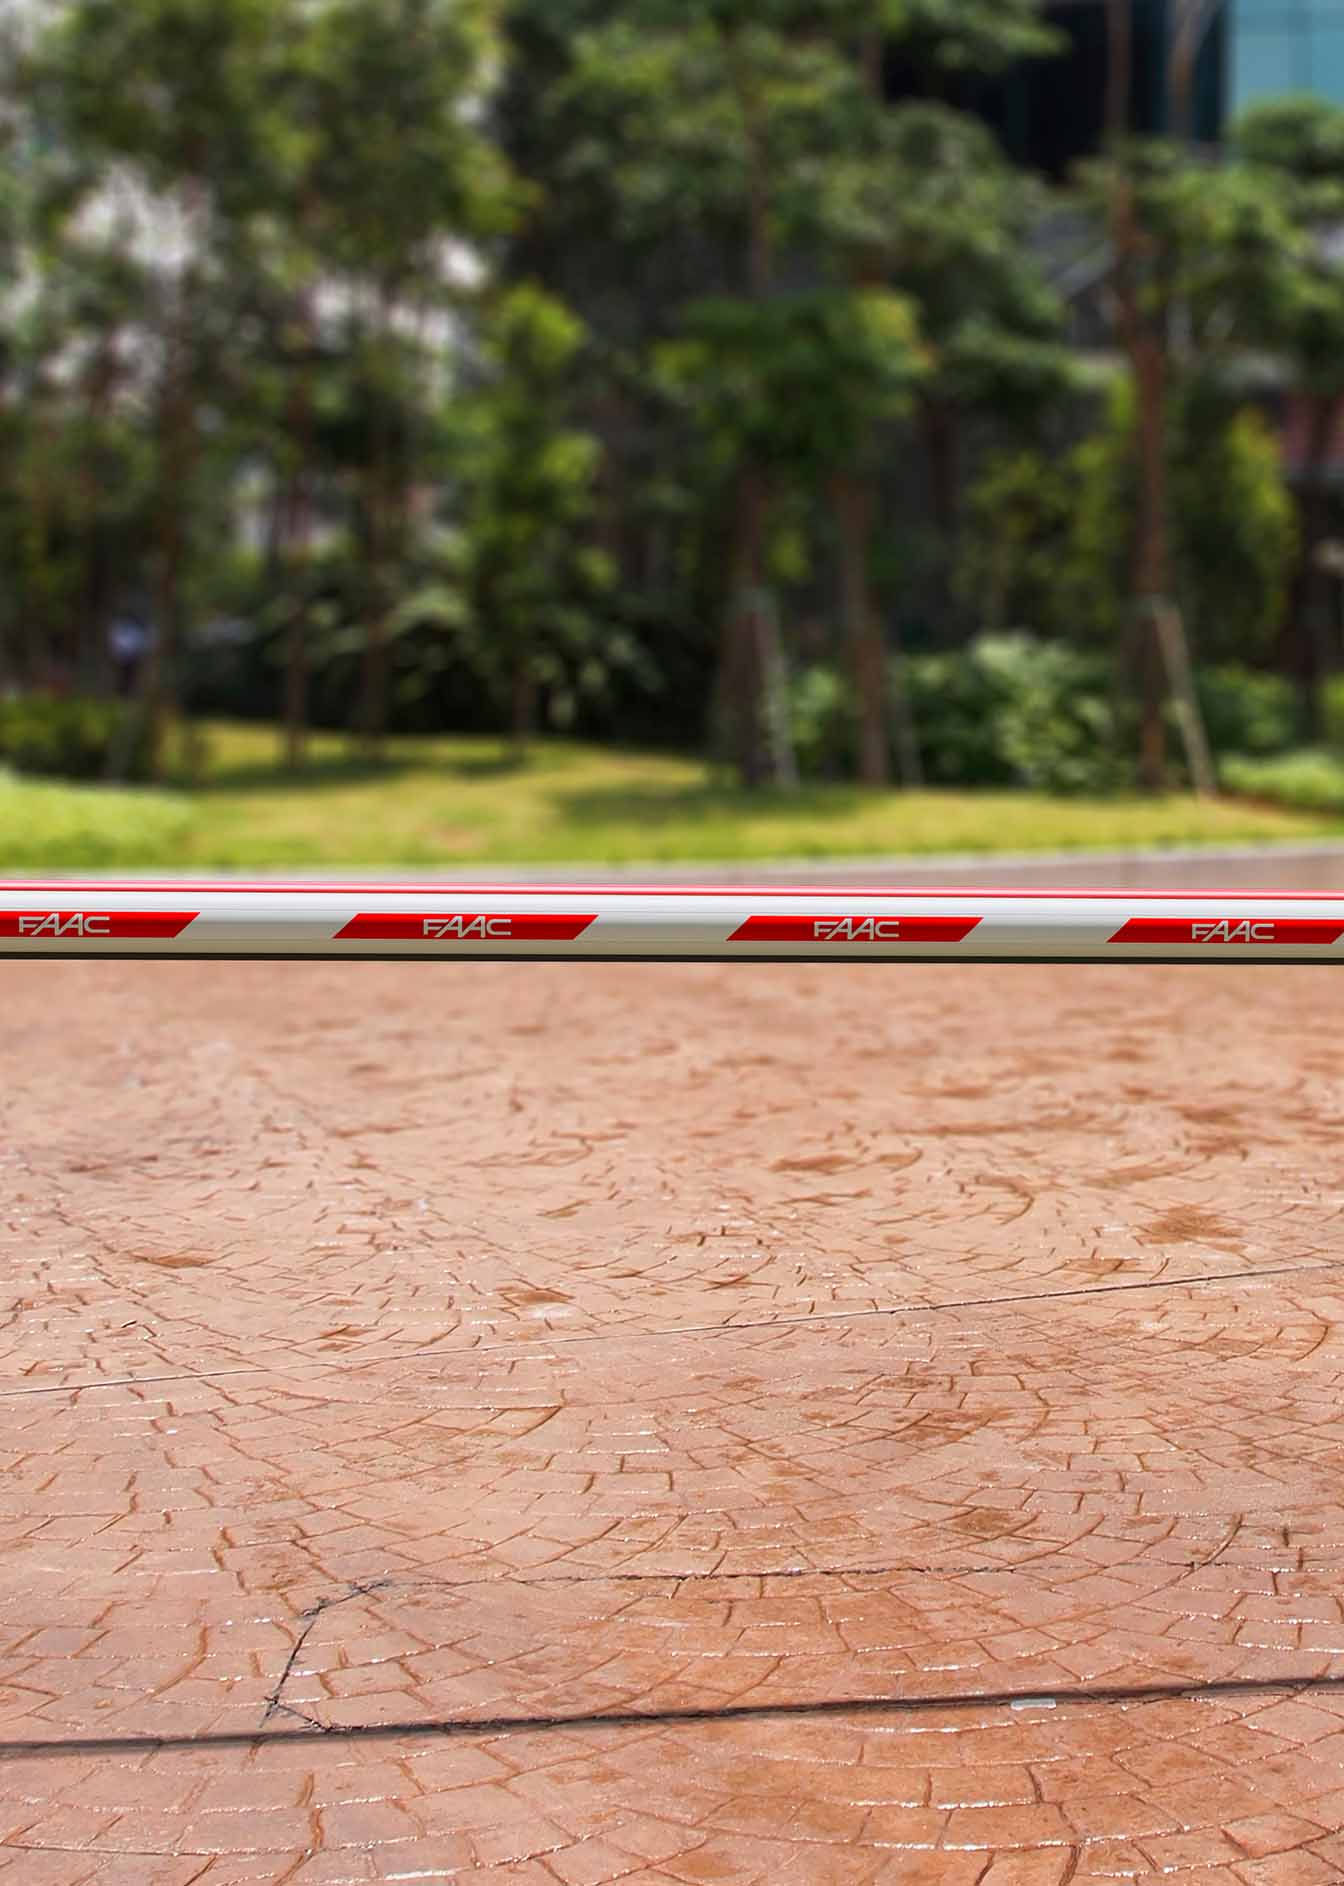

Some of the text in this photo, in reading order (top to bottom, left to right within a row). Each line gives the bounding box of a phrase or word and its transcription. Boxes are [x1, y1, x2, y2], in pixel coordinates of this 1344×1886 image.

[18, 912, 110, 936] FAAC
[423, 915, 512, 938] FAAC
[814, 917, 899, 939] FAAC
[1191, 919, 1275, 942] FAAC
